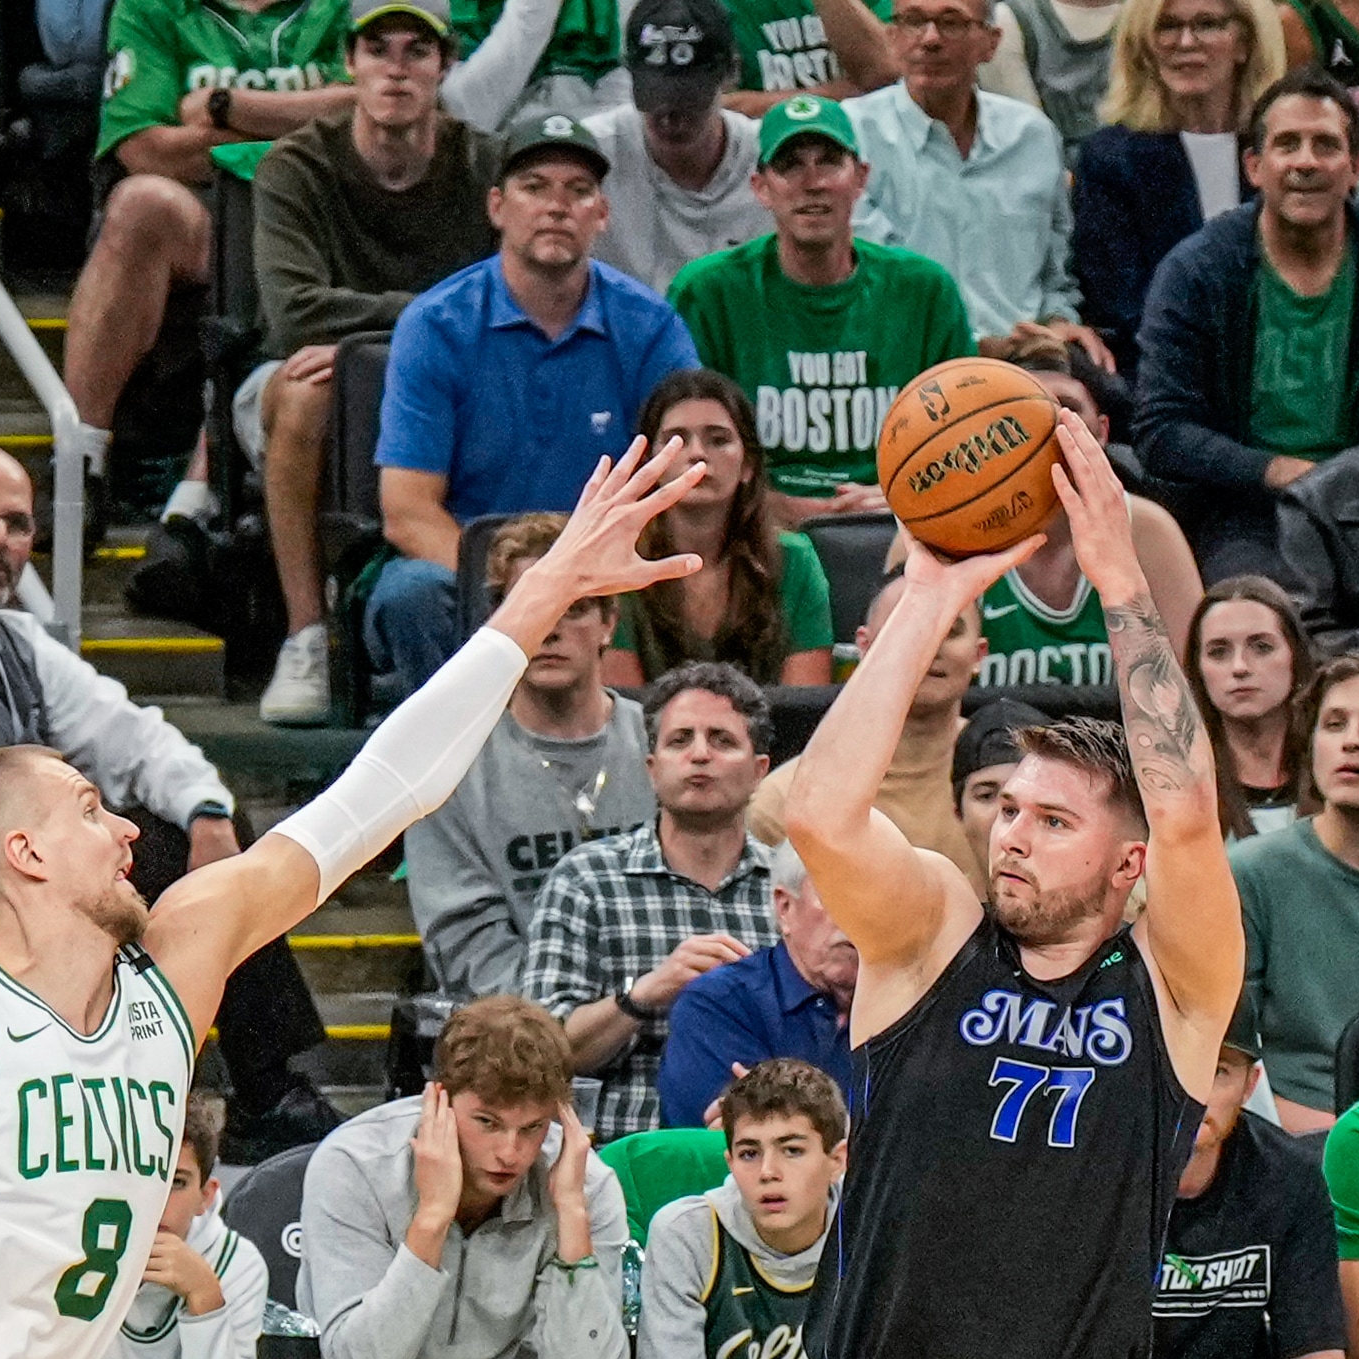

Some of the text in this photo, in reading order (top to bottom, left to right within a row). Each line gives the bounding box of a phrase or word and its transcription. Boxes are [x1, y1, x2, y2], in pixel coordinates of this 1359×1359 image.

[979, 642, 1112, 689] BOSTO
[18, 1073, 176, 1182] CELTICS
[988, 1056, 1096, 1147] 77
[54, 1198, 132, 1321] 8
[1201, 1253, 1261, 1289] SHOT
